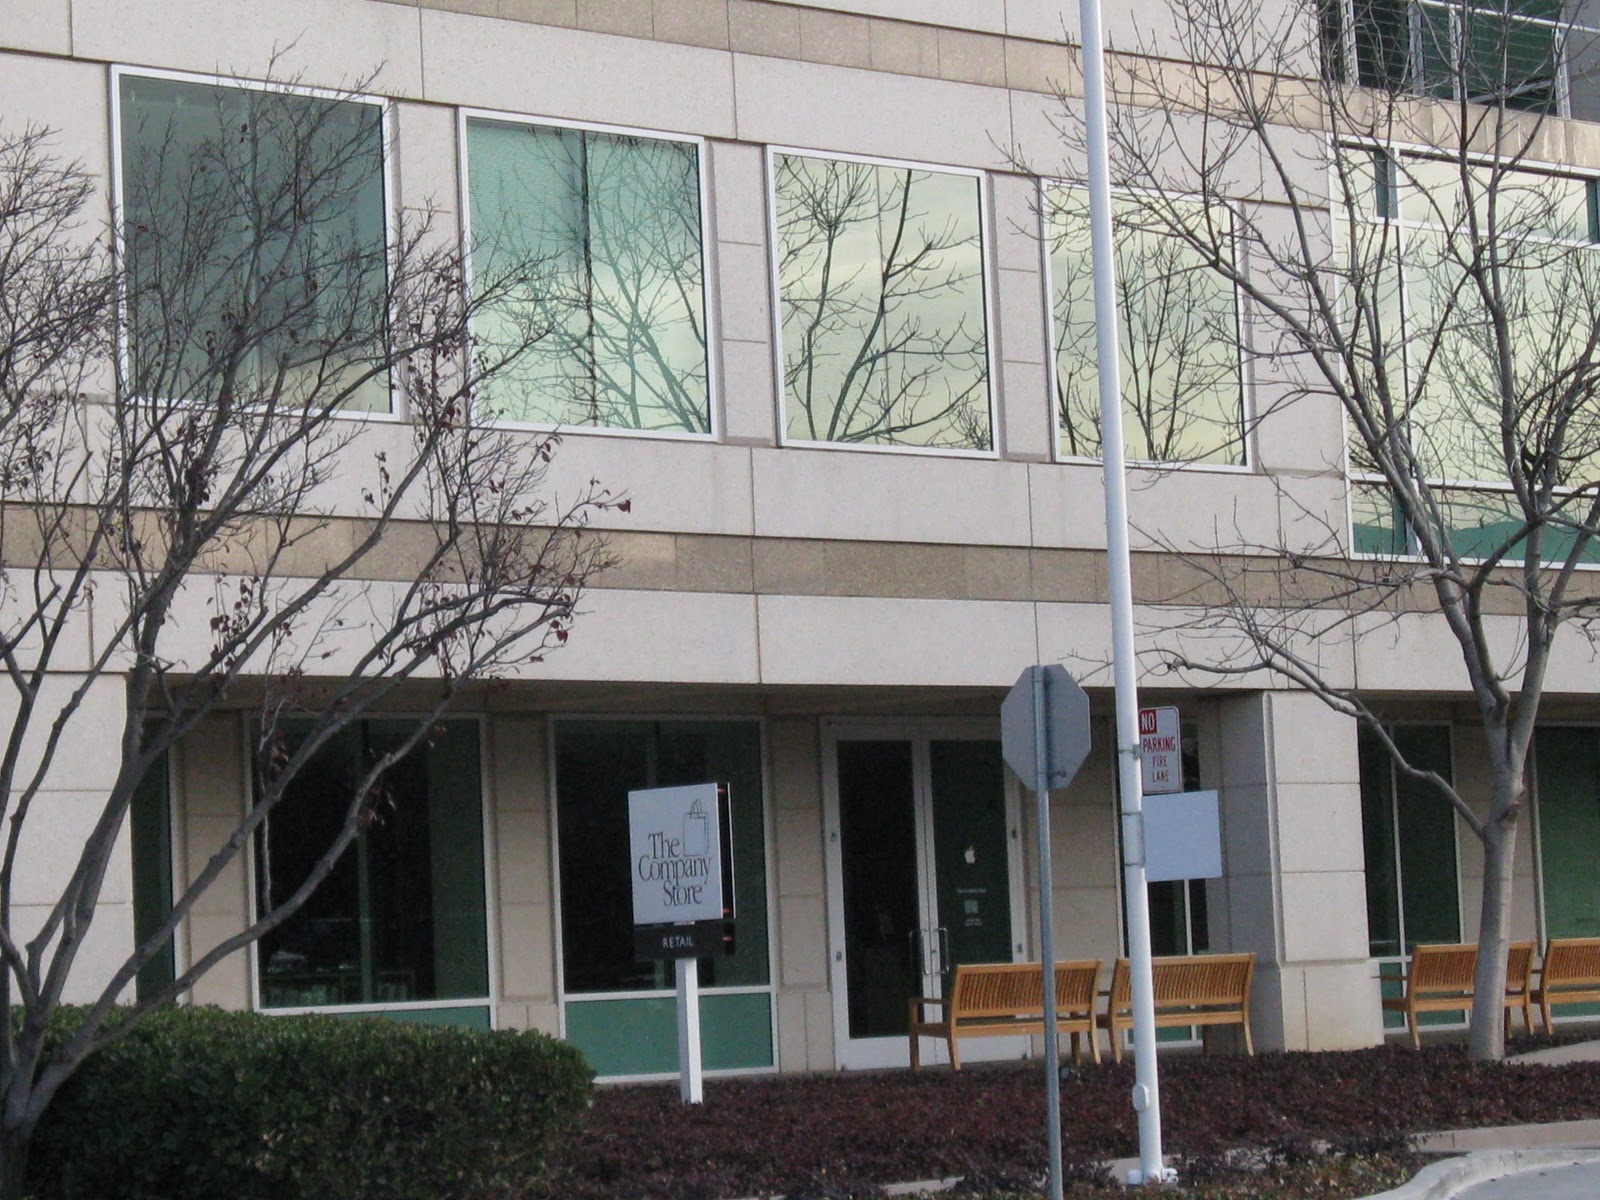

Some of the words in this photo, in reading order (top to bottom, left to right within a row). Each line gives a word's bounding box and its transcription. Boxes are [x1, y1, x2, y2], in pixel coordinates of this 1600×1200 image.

[1141, 711, 1155, 731] NO
[1142, 736, 1176, 753] PARKING
[1152, 755, 1168, 768] FIRE
[1152, 770, 1169, 783] LANE
[648, 832, 680, 860] The
[638, 855, 712, 885] Company
[663, 880, 702, 907] Store
[662, 936, 694, 949] RETAIL
